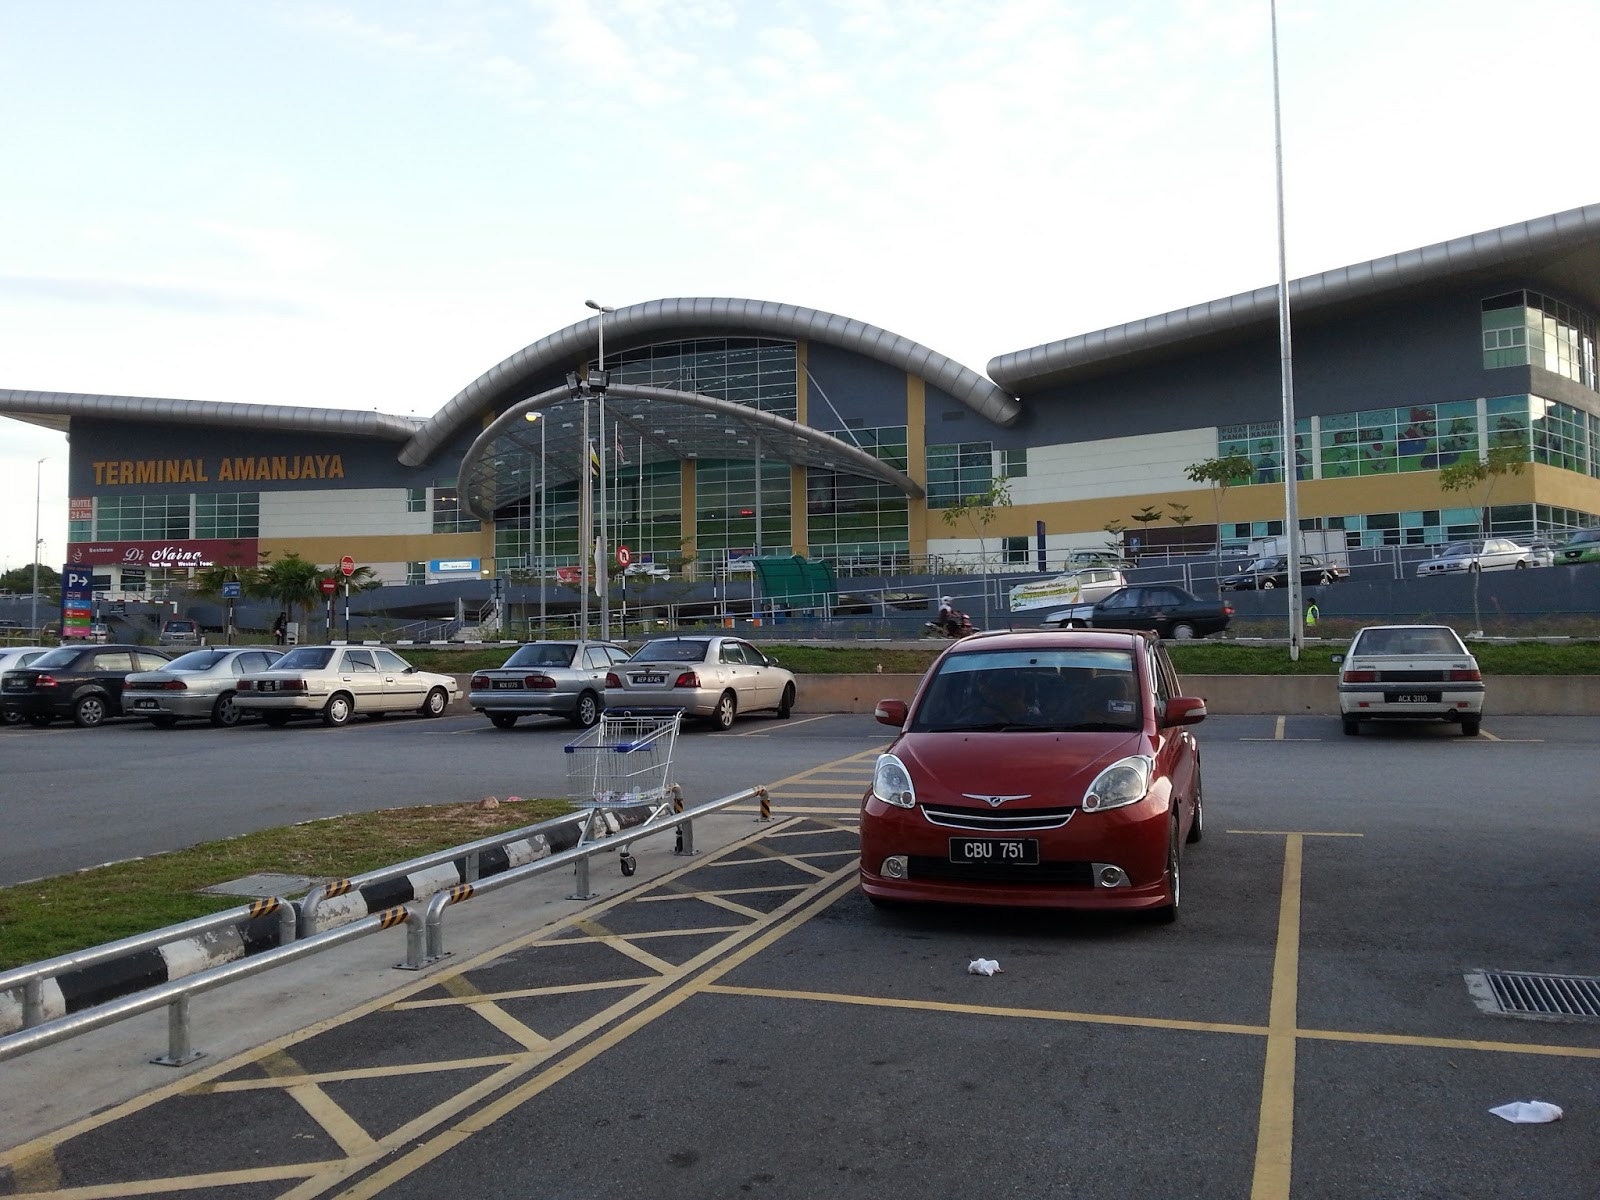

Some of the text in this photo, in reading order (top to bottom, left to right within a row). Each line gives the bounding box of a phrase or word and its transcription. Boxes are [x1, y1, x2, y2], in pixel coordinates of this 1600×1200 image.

[1222, 425, 1248, 434] PUSAT
[92, 455, 345, 486] TERMINAL AMANJAYA
[71, 499, 91, 508] HOTEL
[122, 546, 202, 561] Di Naina
[69, 573, 79, 588] P
[1398, 694, 1428, 703] ACX 3110
[964, 842, 1024, 859] CBU 751
